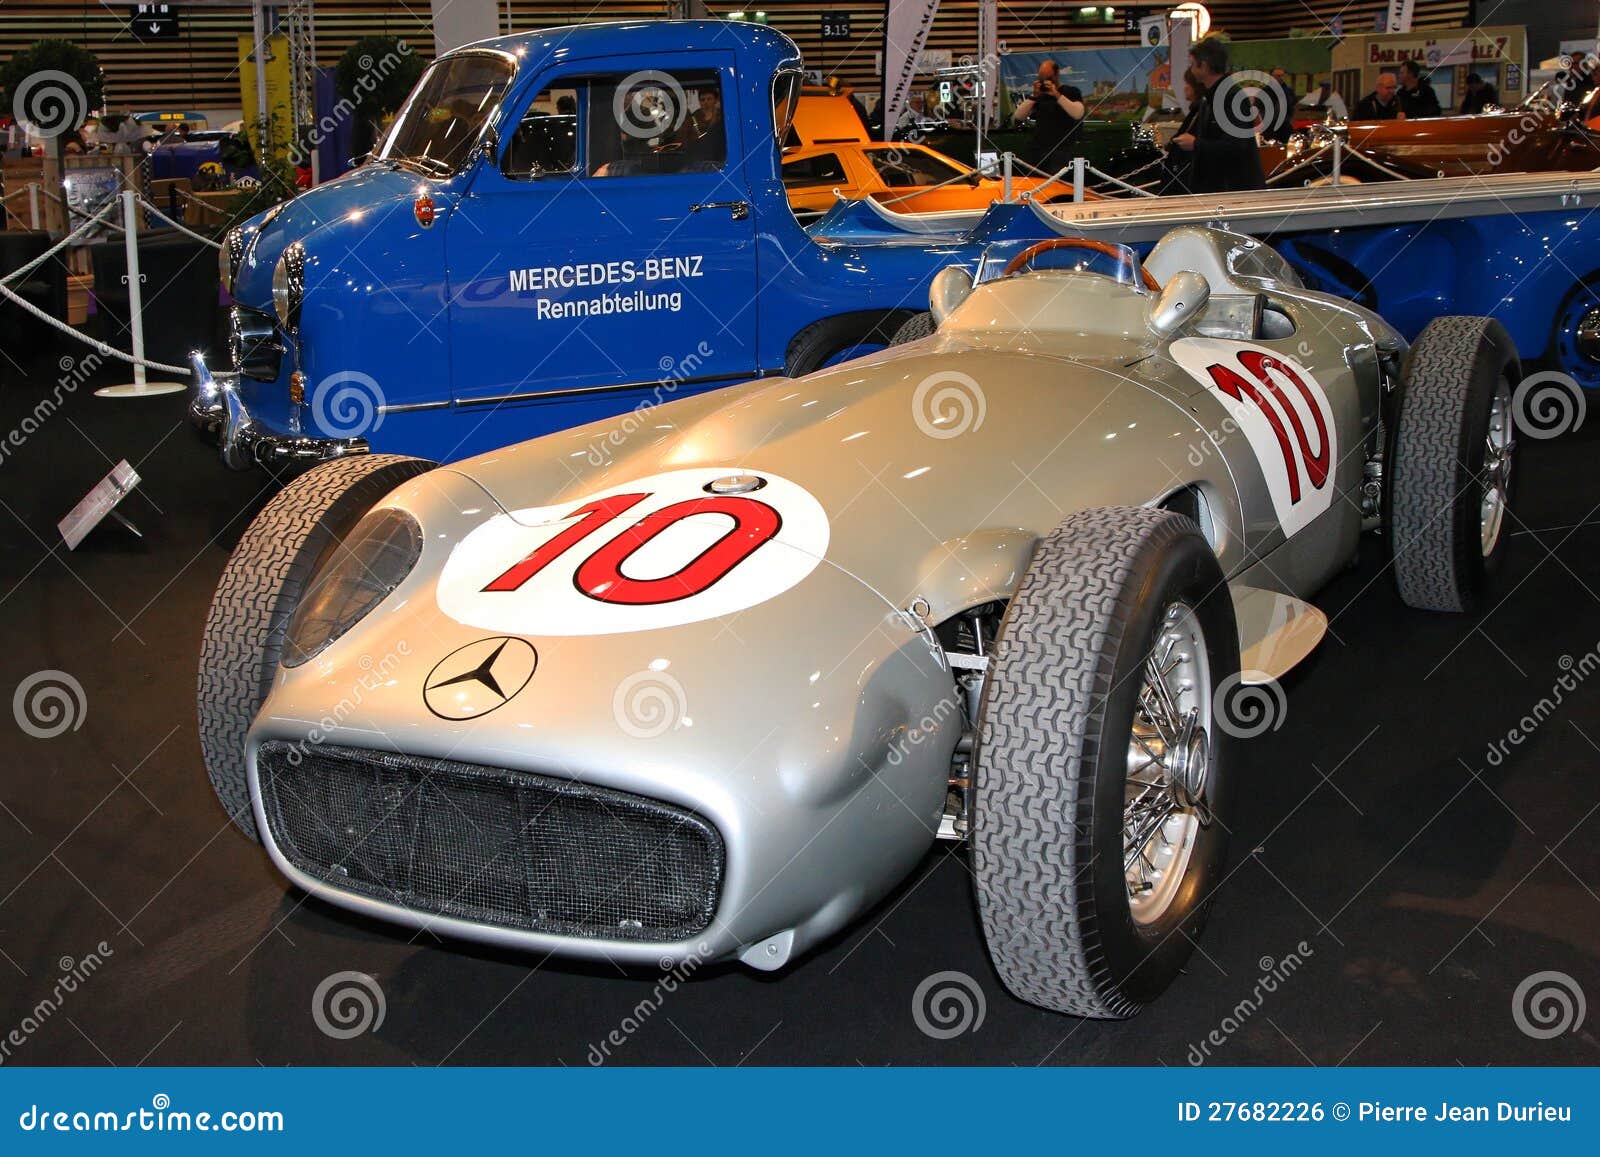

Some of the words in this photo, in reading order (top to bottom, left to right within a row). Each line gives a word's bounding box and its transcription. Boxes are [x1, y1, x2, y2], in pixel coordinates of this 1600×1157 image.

[824, 25, 848, 36] 3.15
[509, 255, 704, 292] MERCEDES-BENZ
[536, 290, 682, 321] Rennabteilung
[1205, 350, 1331, 506] 10
[479, 492, 783, 606] 10
